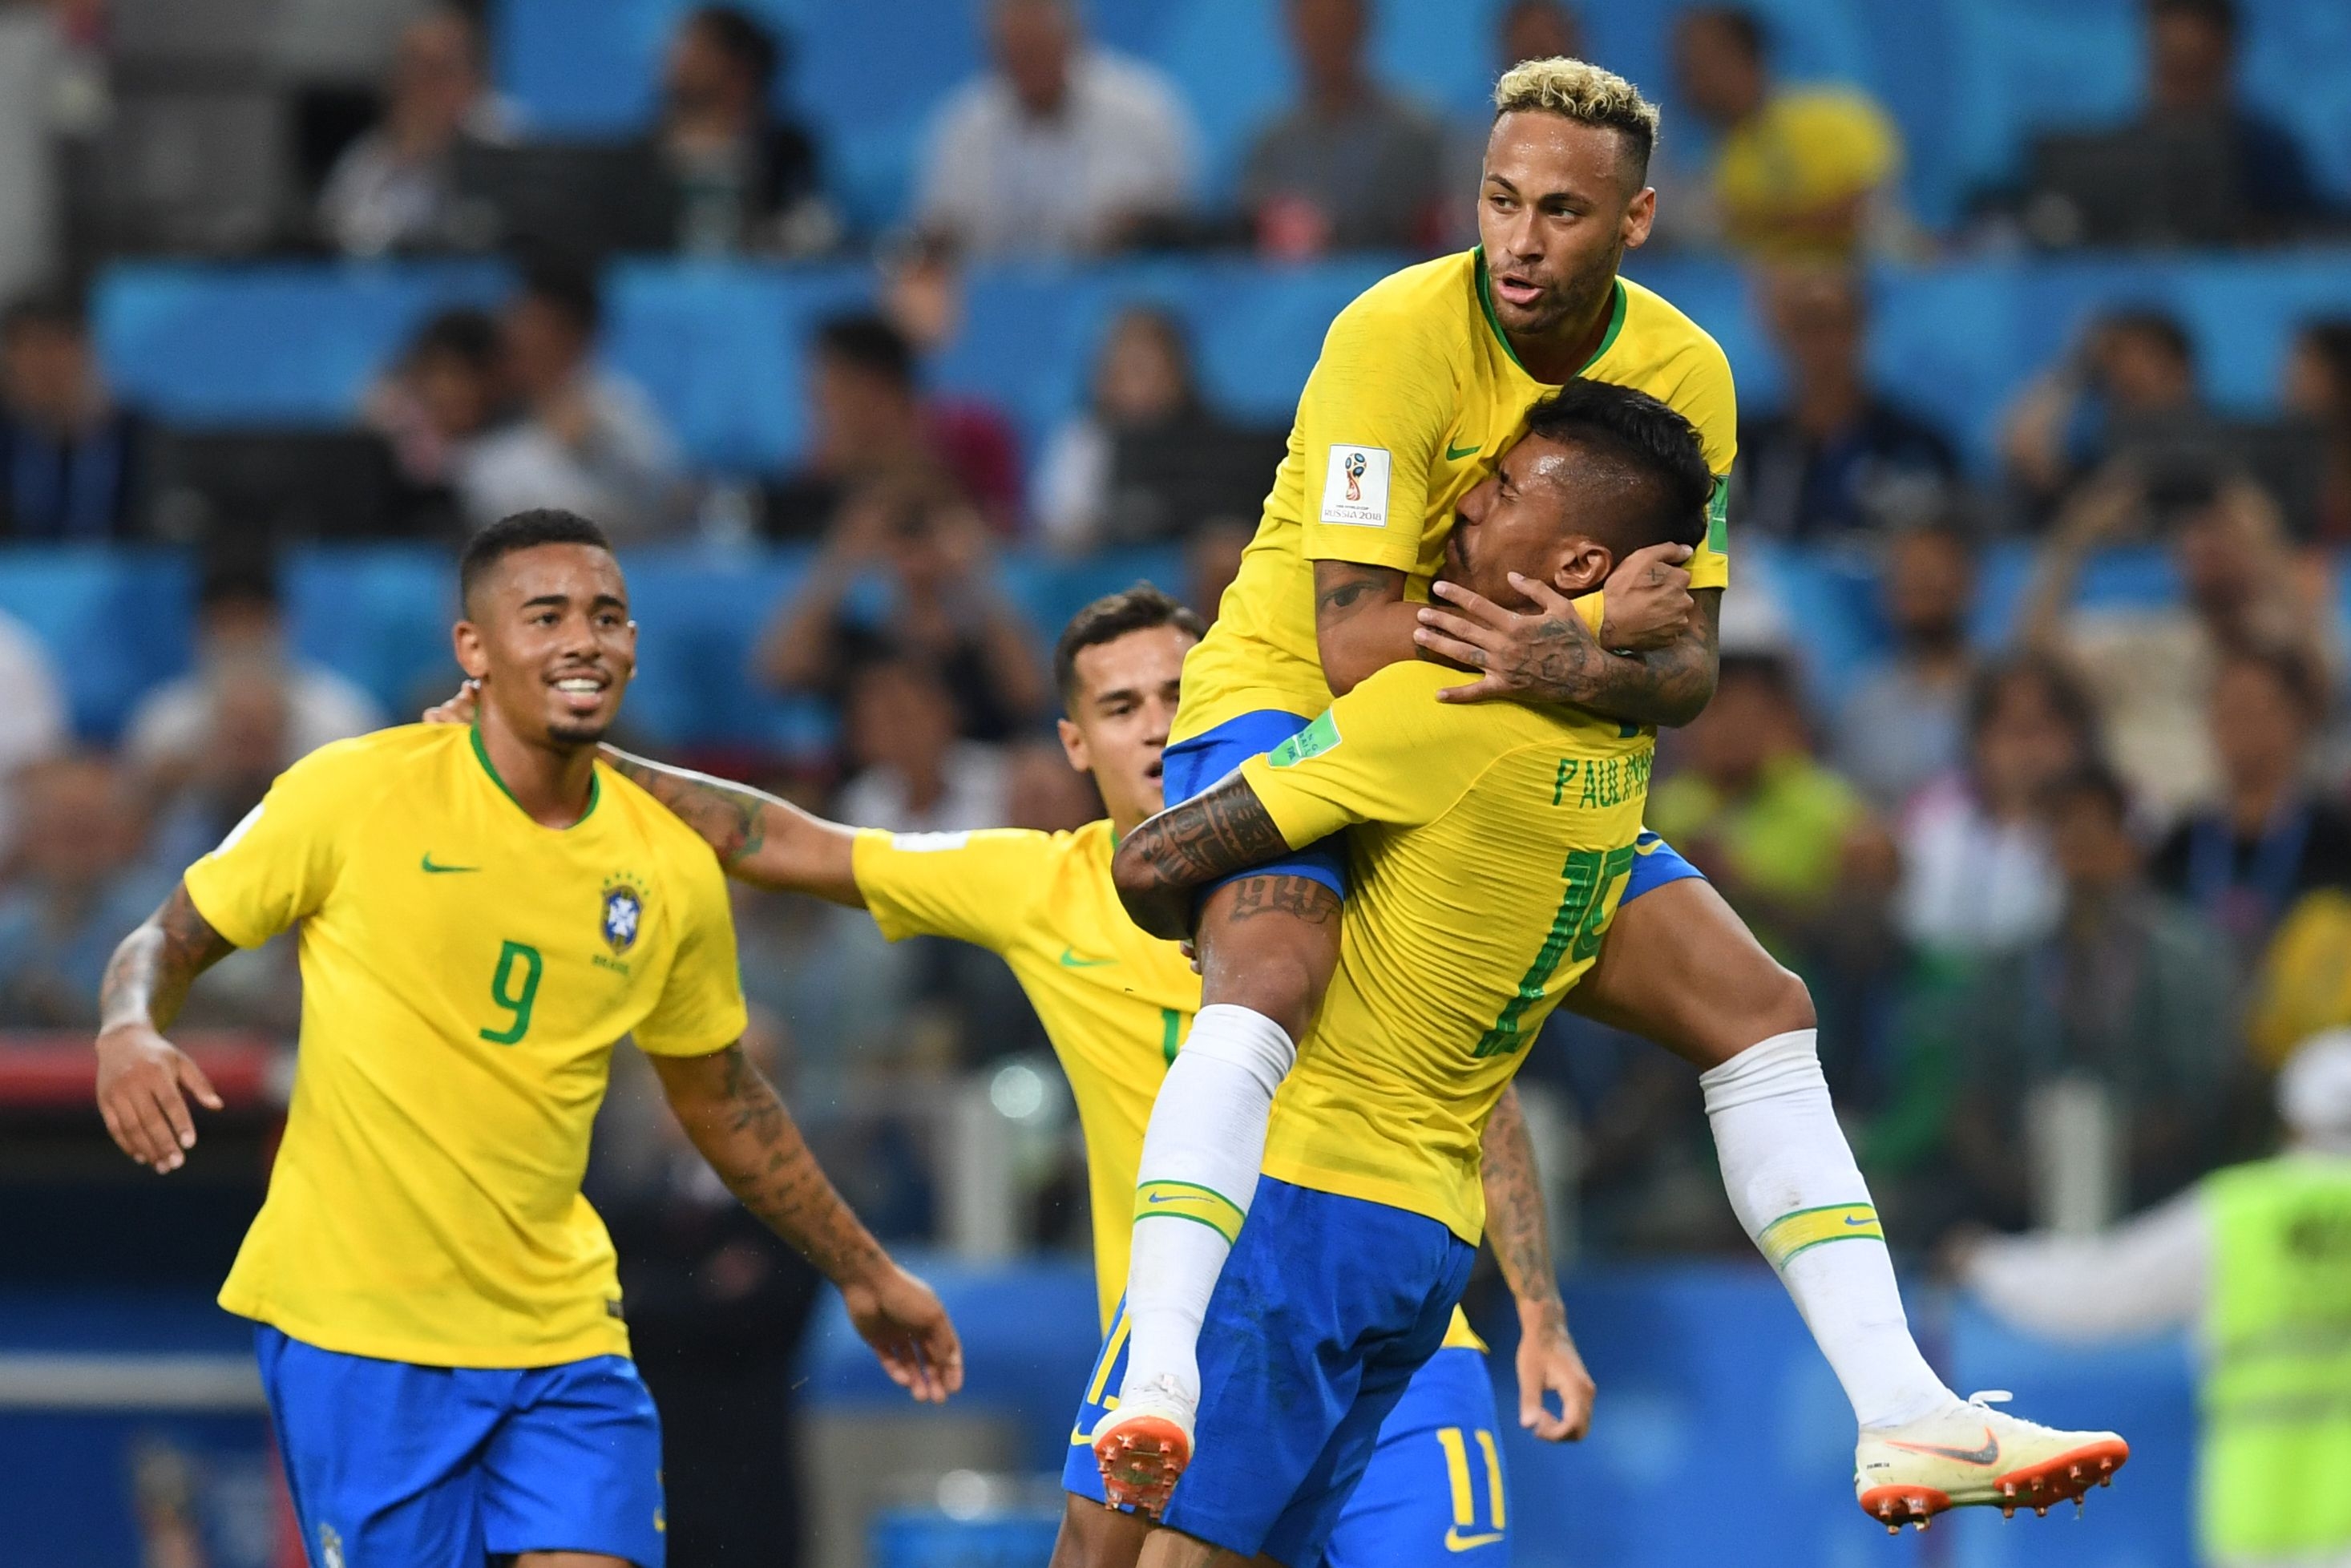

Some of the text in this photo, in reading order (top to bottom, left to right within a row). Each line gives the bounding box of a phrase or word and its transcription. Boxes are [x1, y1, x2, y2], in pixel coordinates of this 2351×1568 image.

[1324, 509, 1382, 521] RUSSIA 2018
[479, 939, 543, 1045] 9
[1436, 1427, 1505, 1530] 11
